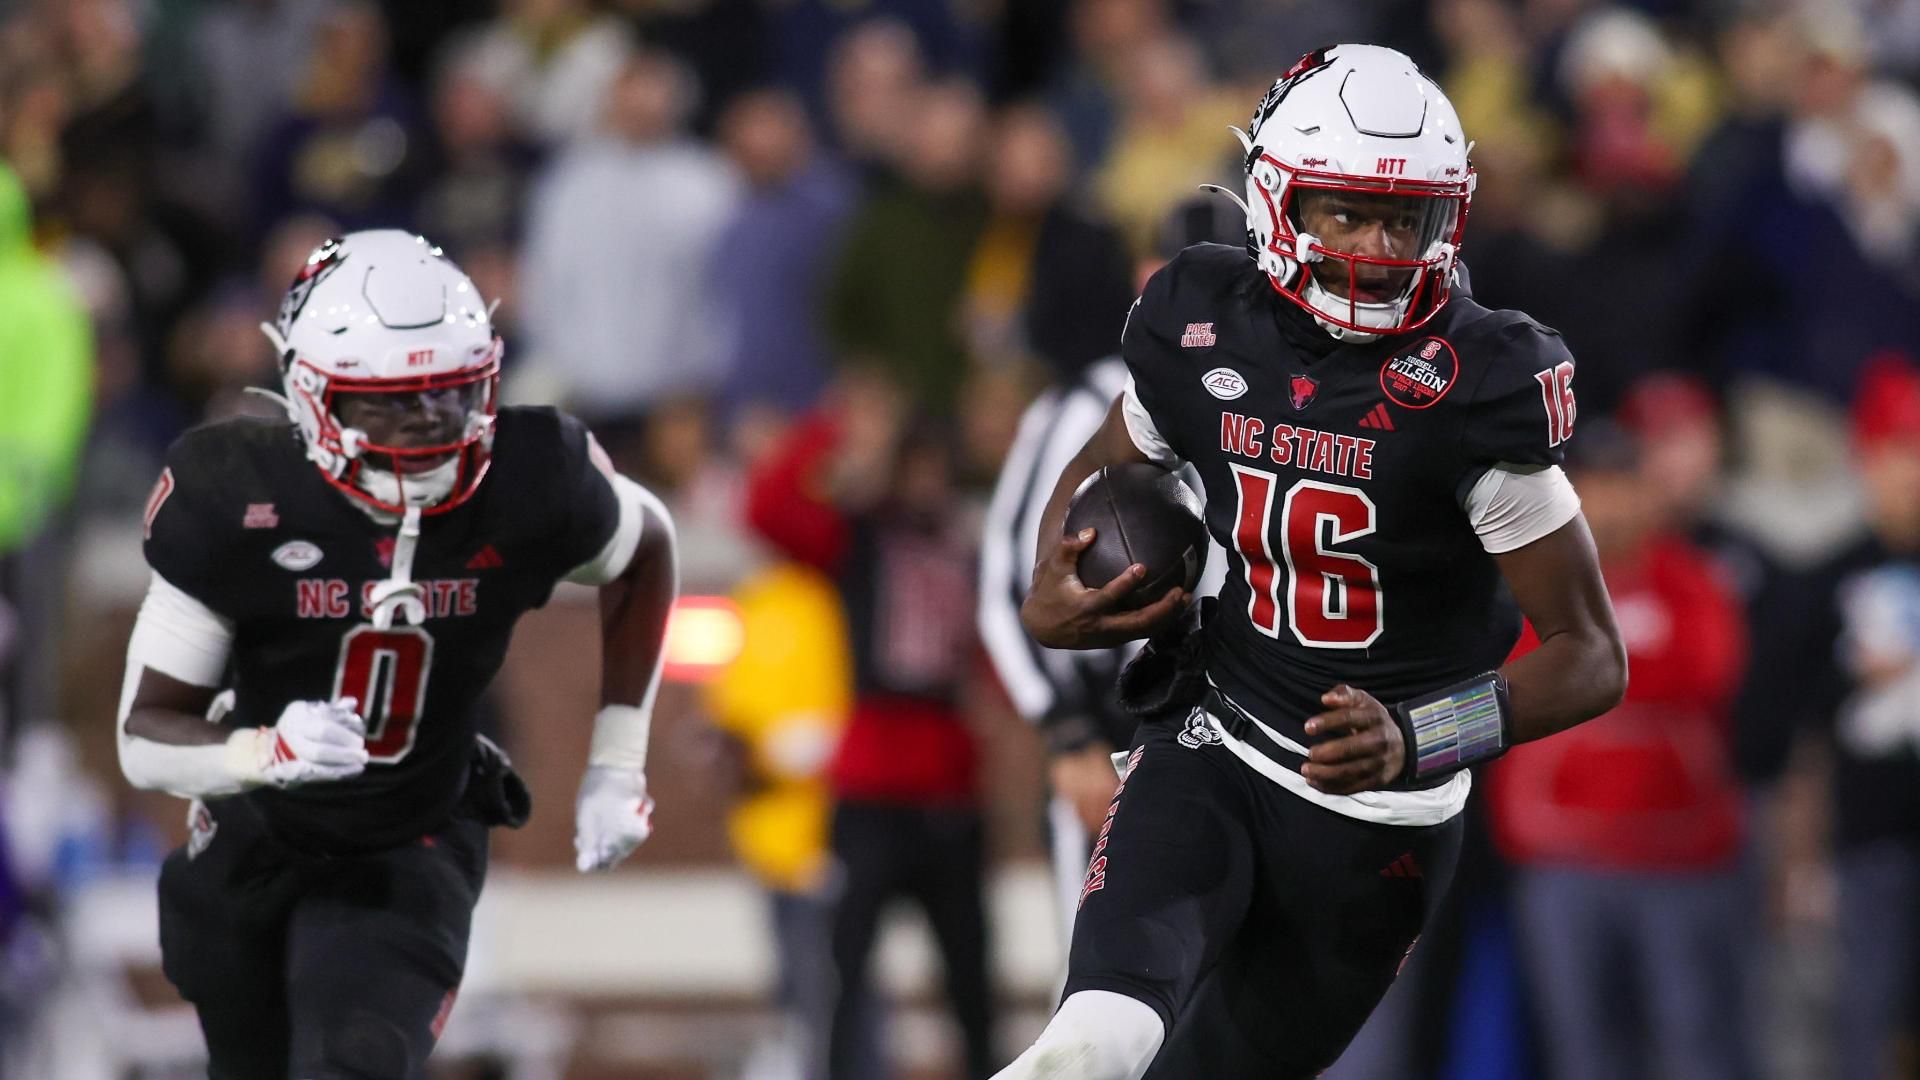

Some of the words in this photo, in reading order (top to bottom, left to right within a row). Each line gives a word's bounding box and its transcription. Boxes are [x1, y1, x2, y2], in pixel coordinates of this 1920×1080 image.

[1376, 158, 1406, 175] HTT
[1181, 334, 1216, 347] UNITED
[1185, 323, 1213, 335] PACK
[407, 350, 434, 367] HTT
[1405, 355, 1438, 374] RUSSELL
[1211, 377, 1240, 389] ACC
[1389, 358, 1447, 393] WILSON
[1533, 360, 1577, 448] 16
[1221, 411, 1264, 458] NC
[1270, 423, 1376, 480] STATE
[1228, 462, 1384, 649] 16
[297, 578, 350, 618] NC
[332, 623, 434, 764] 0
